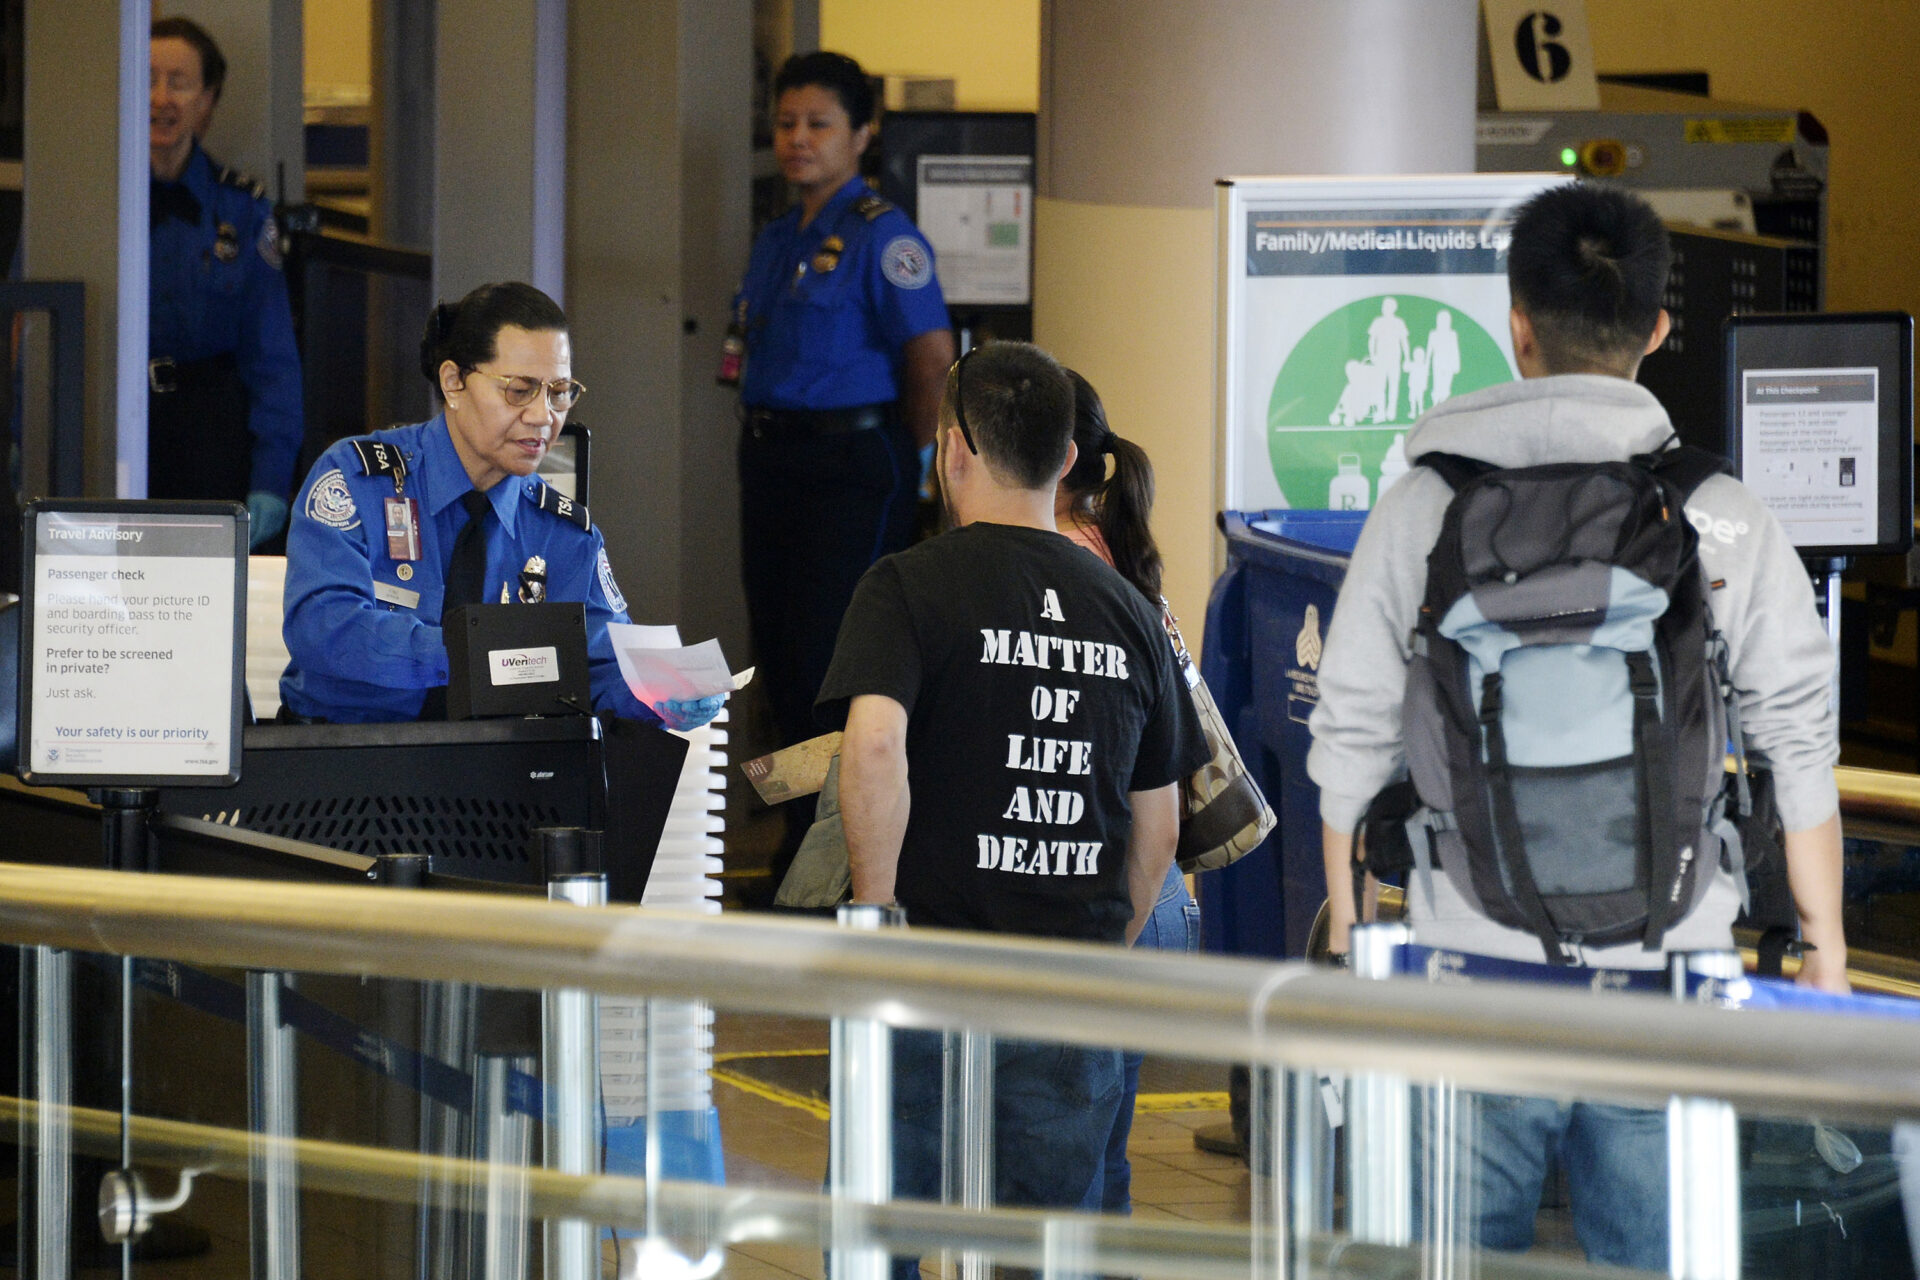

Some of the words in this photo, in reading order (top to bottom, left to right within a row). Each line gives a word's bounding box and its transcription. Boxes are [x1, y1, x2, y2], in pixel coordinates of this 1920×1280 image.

[1514, 11, 1572, 84] 6
[1256, 230, 1407, 254] Family/Medical
[1406, 229, 1476, 253] Liquids
[373, 443, 390, 470] TSA
[557, 495, 573, 517] TSA
[48, 528, 86, 541] Travel
[88, 528, 144, 543] Advisory
[47, 569, 109, 582] Passenger
[111, 570, 145, 581] check
[48, 593, 86, 605] Please
[88, 594, 119, 605] hand
[122, 596, 150, 608] your
[152, 595, 194, 607] picture
[197, 595, 211, 606] ID
[1040, 588, 1066, 622] A
[46, 608, 70, 620] and
[72, 609, 126, 622] boarding
[128, 612, 155, 622] pass
[157, 610, 170, 621] to
[173, 610, 193, 621] the
[46, 624, 95, 637] security
[97, 624, 140, 636] officer.
[46, 648, 85, 660] Prefer
[86, 649, 100, 660] to
[101, 648, 118, 660] be
[119, 649, 174, 661] screened
[501, 655, 547, 668] UVeritech
[980, 629, 1130, 680] MATTER
[46, 663, 58, 674] in
[60, 663, 110, 675] private?
[46, 687, 70, 699] Just
[73, 688, 97, 699] ask.
[1031, 685, 1080, 723] OF
[55, 726, 83, 738] Your
[86, 727, 123, 740] safety
[126, 726, 137, 738] is
[139, 729, 160, 739] our
[162, 728, 209, 741] priority
[1005, 734, 1092, 775] LIFE
[1002, 785, 1085, 825] AND
[976, 834, 1103, 876] DEATH
